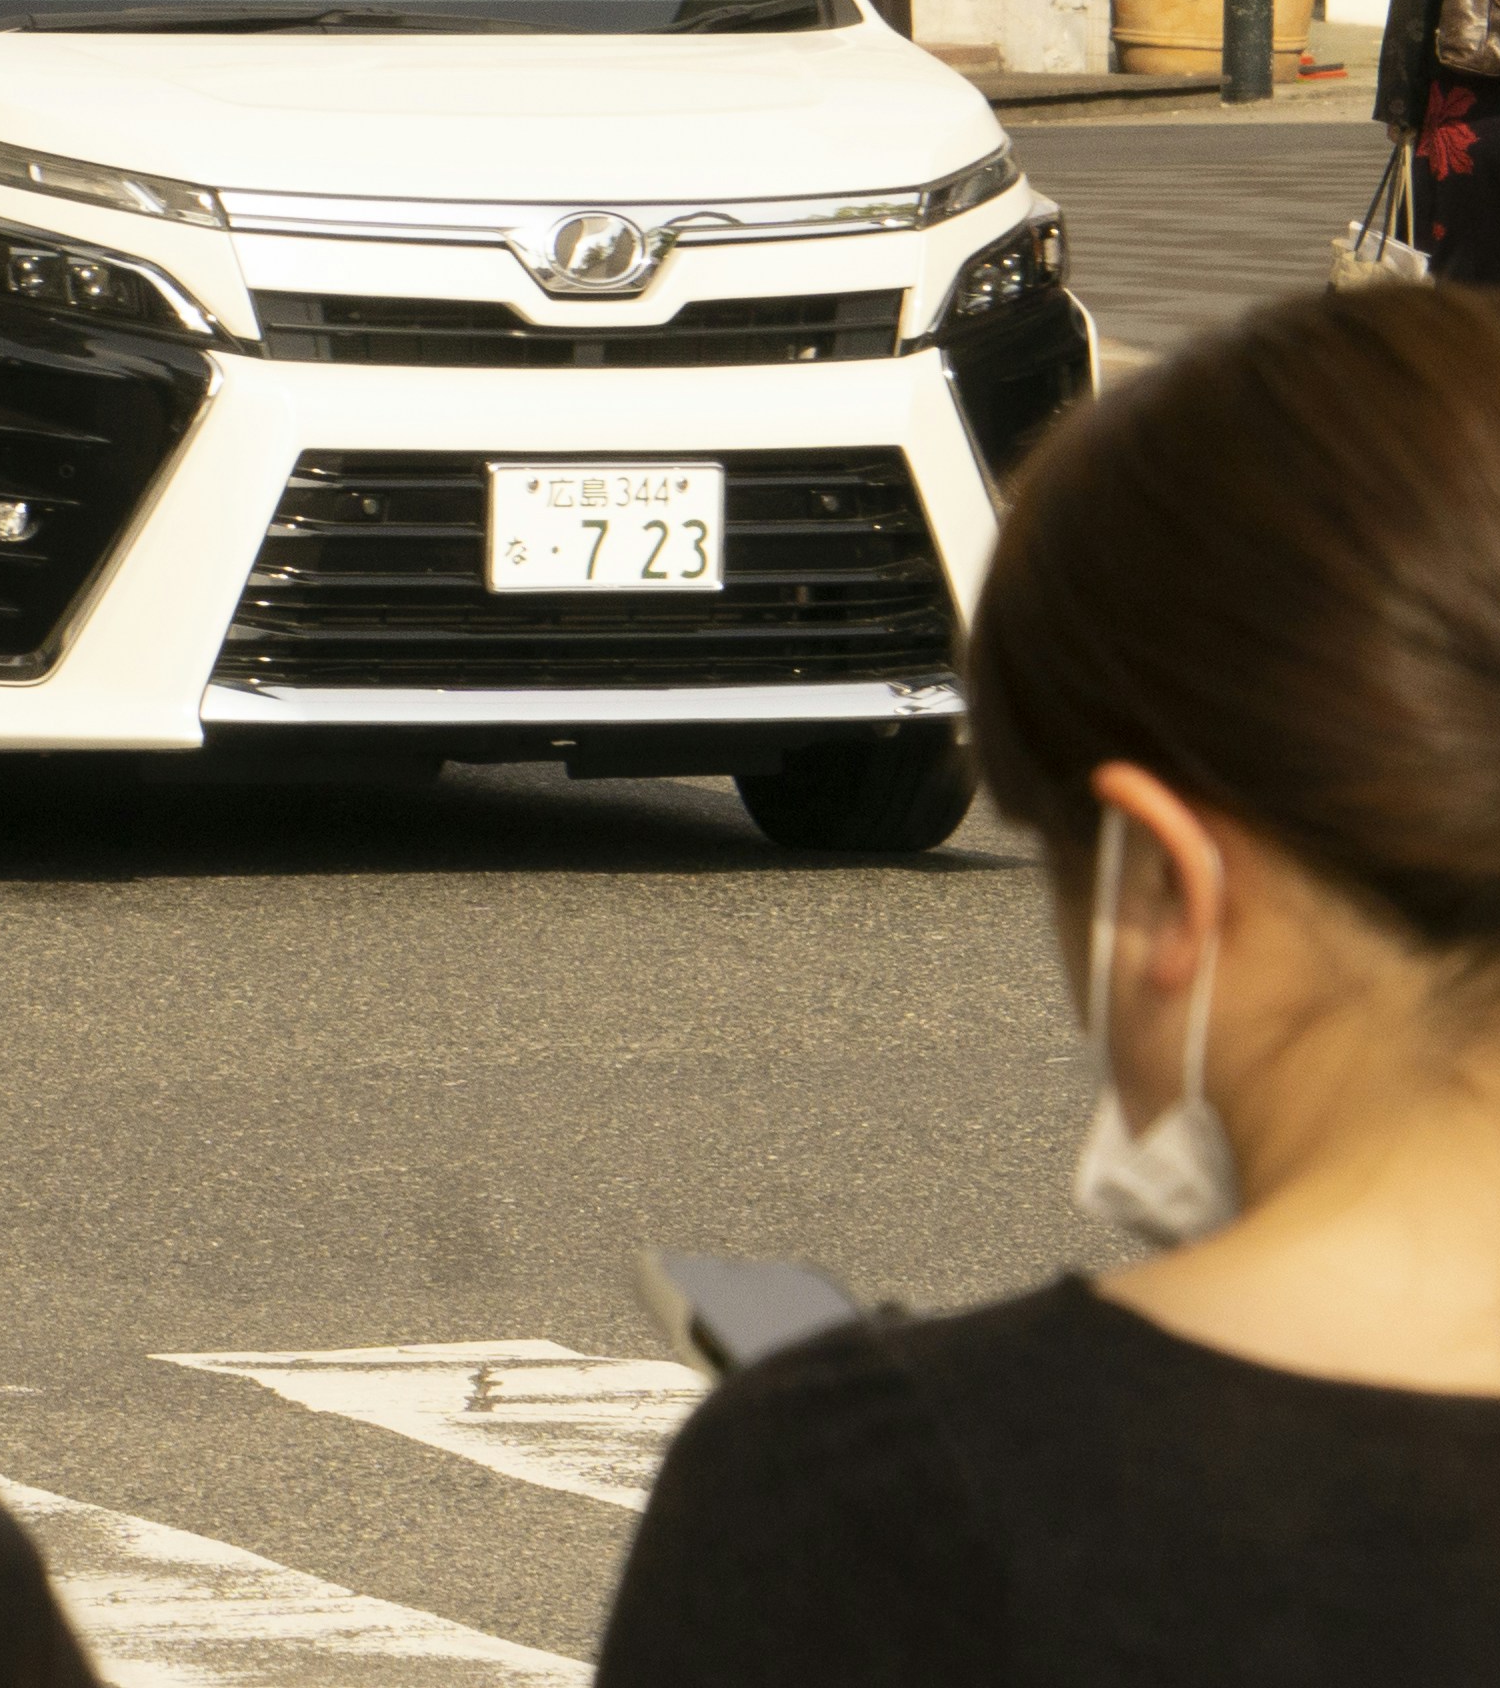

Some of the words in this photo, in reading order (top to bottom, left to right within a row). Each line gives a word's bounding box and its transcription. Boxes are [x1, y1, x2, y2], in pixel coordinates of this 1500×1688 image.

[548, 477, 609, 508] 広島
[614, 476, 671, 507] 344
[504, 537, 528, 566] な
